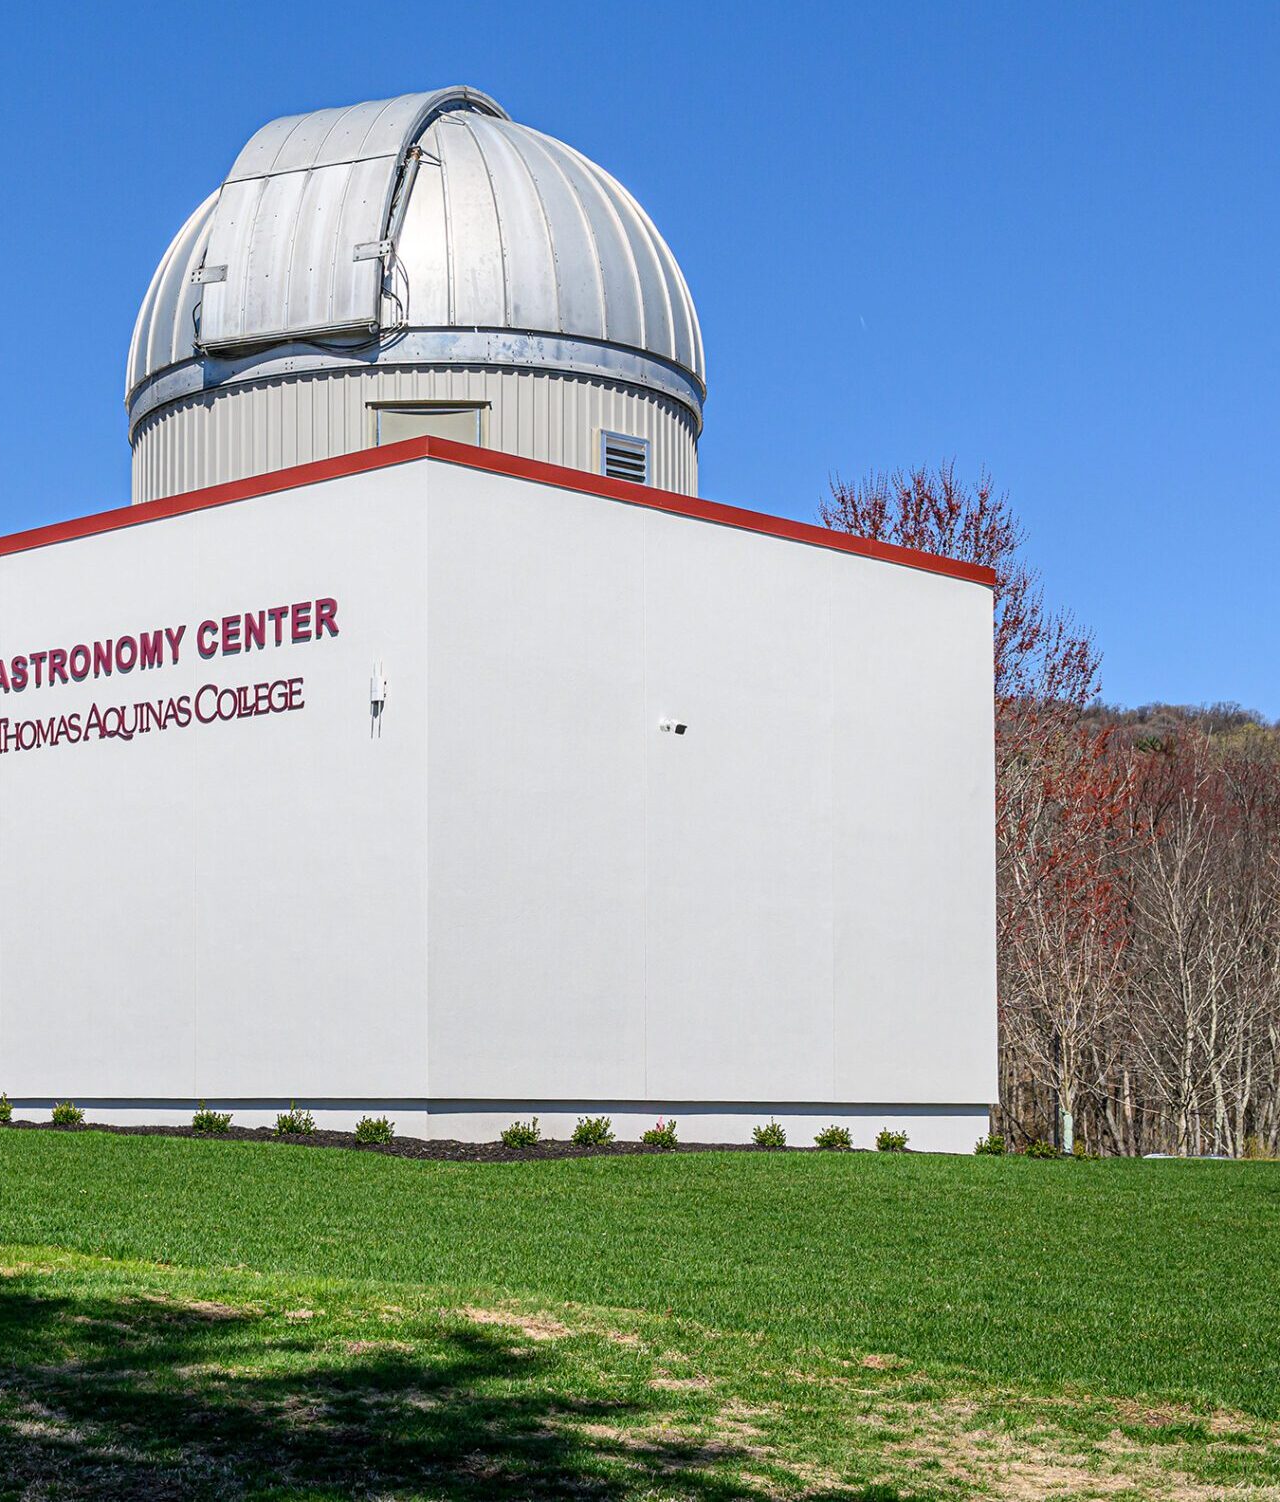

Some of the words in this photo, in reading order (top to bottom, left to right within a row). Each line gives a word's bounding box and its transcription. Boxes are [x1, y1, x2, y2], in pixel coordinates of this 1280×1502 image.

[196, 597, 340, 660] CENTER
[83, 695, 193, 741] AQUINAS
[194, 677, 305, 724] COLLEGE
